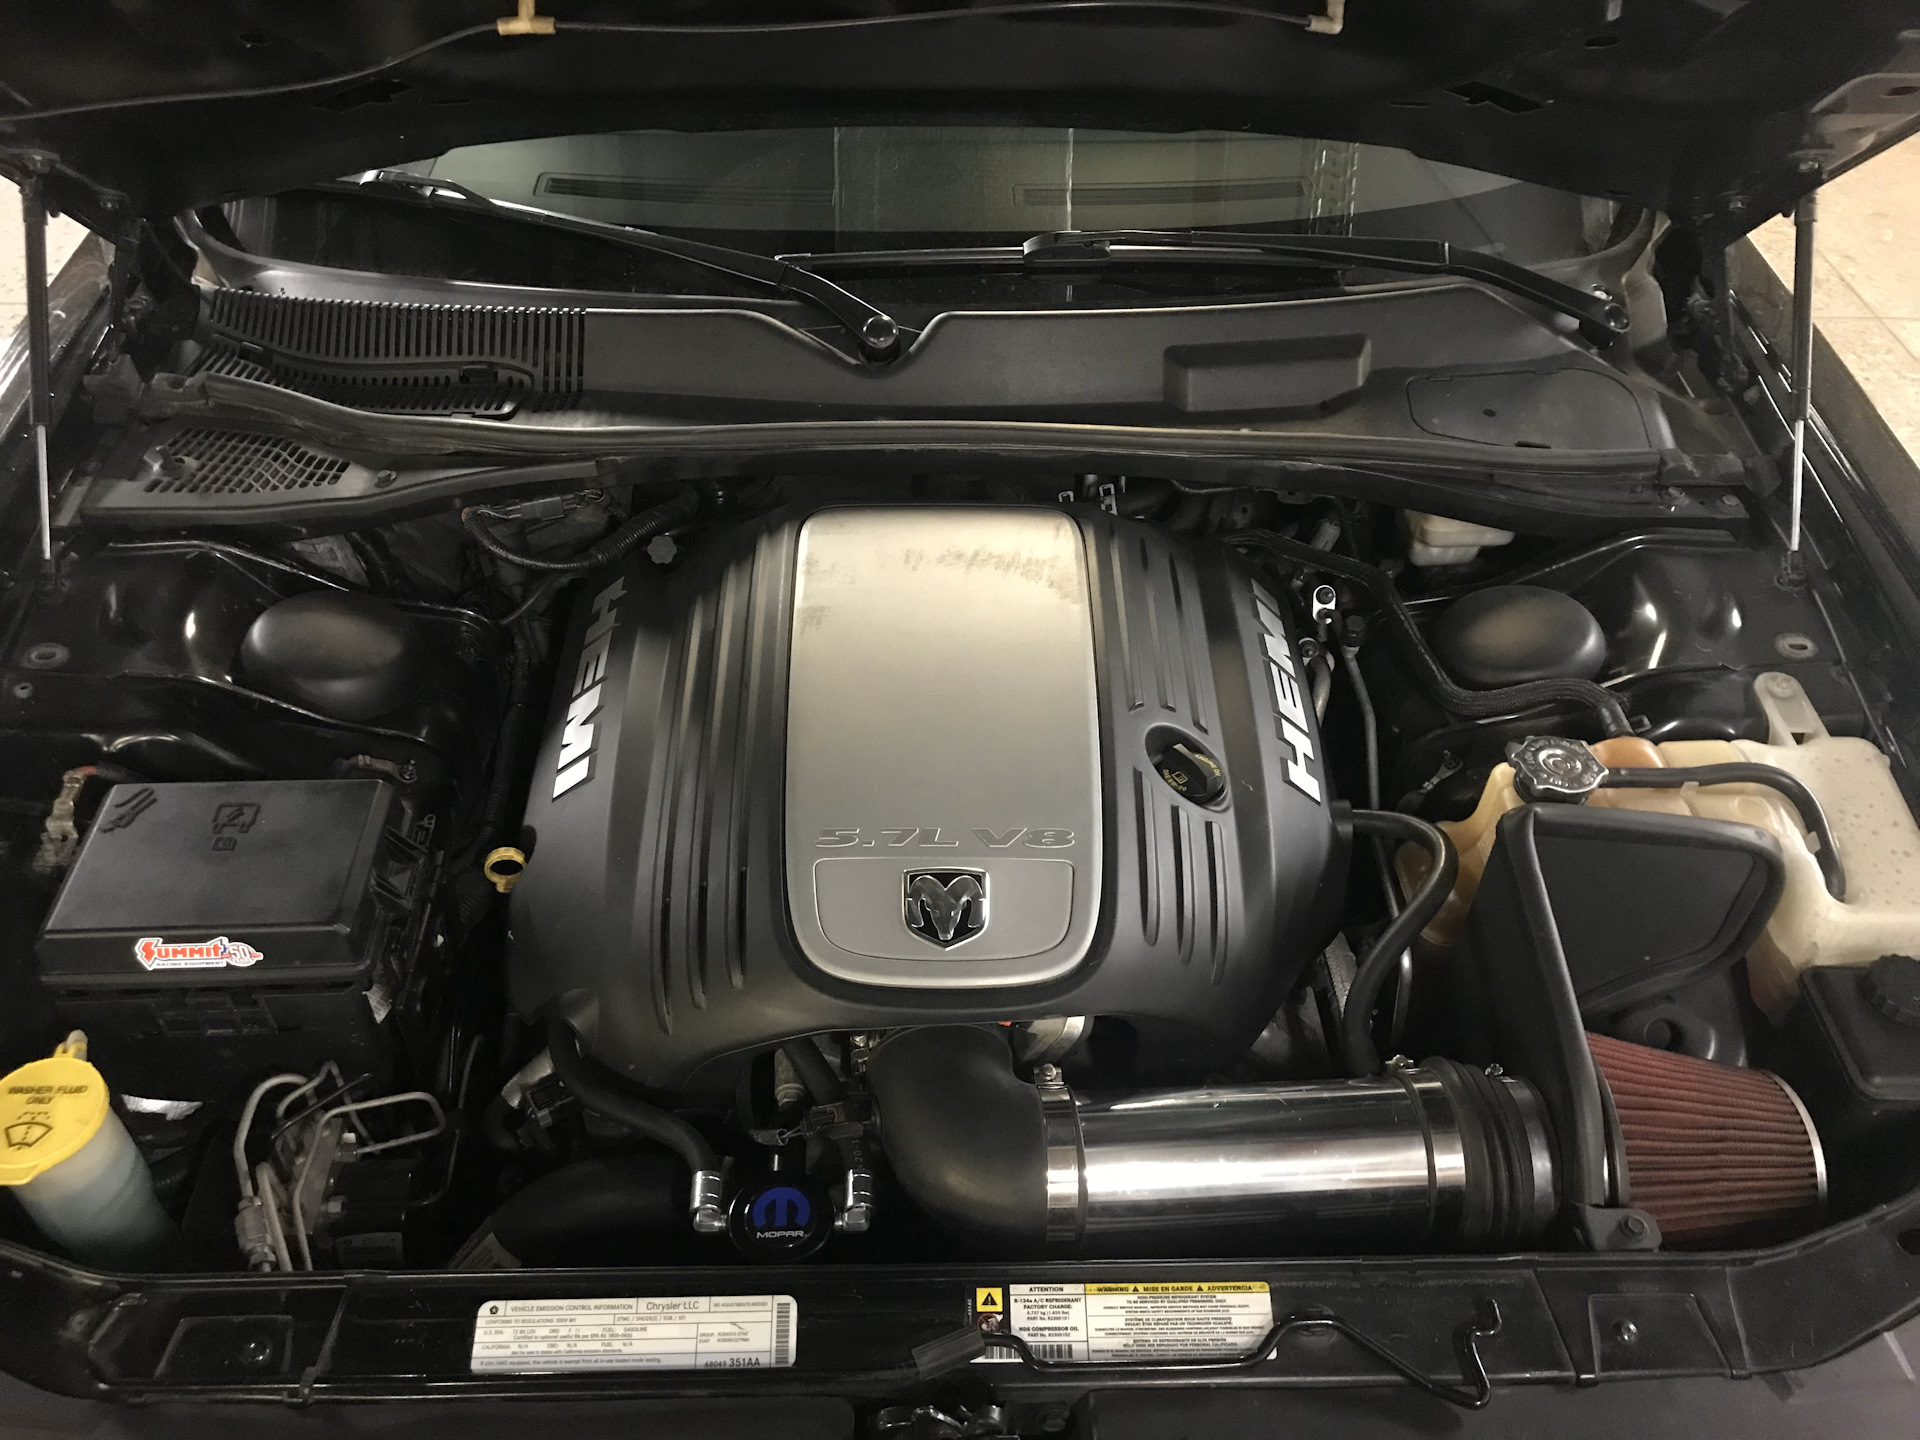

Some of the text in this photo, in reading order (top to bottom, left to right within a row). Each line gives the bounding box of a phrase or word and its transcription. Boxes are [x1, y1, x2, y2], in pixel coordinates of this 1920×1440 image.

[551, 576, 627, 802] HEMI
[1250, 577, 1321, 804] HEMI
[1194, 754, 1218, 769] ENGINE
[815, 827, 1077, 849] 5.7L V8
[229, 944, 250, 960] 50
[8, 1085, 89, 1095] WASHER FLUID
[26, 1096, 56, 1105] ONLY
[756, 1230, 805, 1239] MOPAR
[646, 1301, 700, 1312] Chrysler LLC
